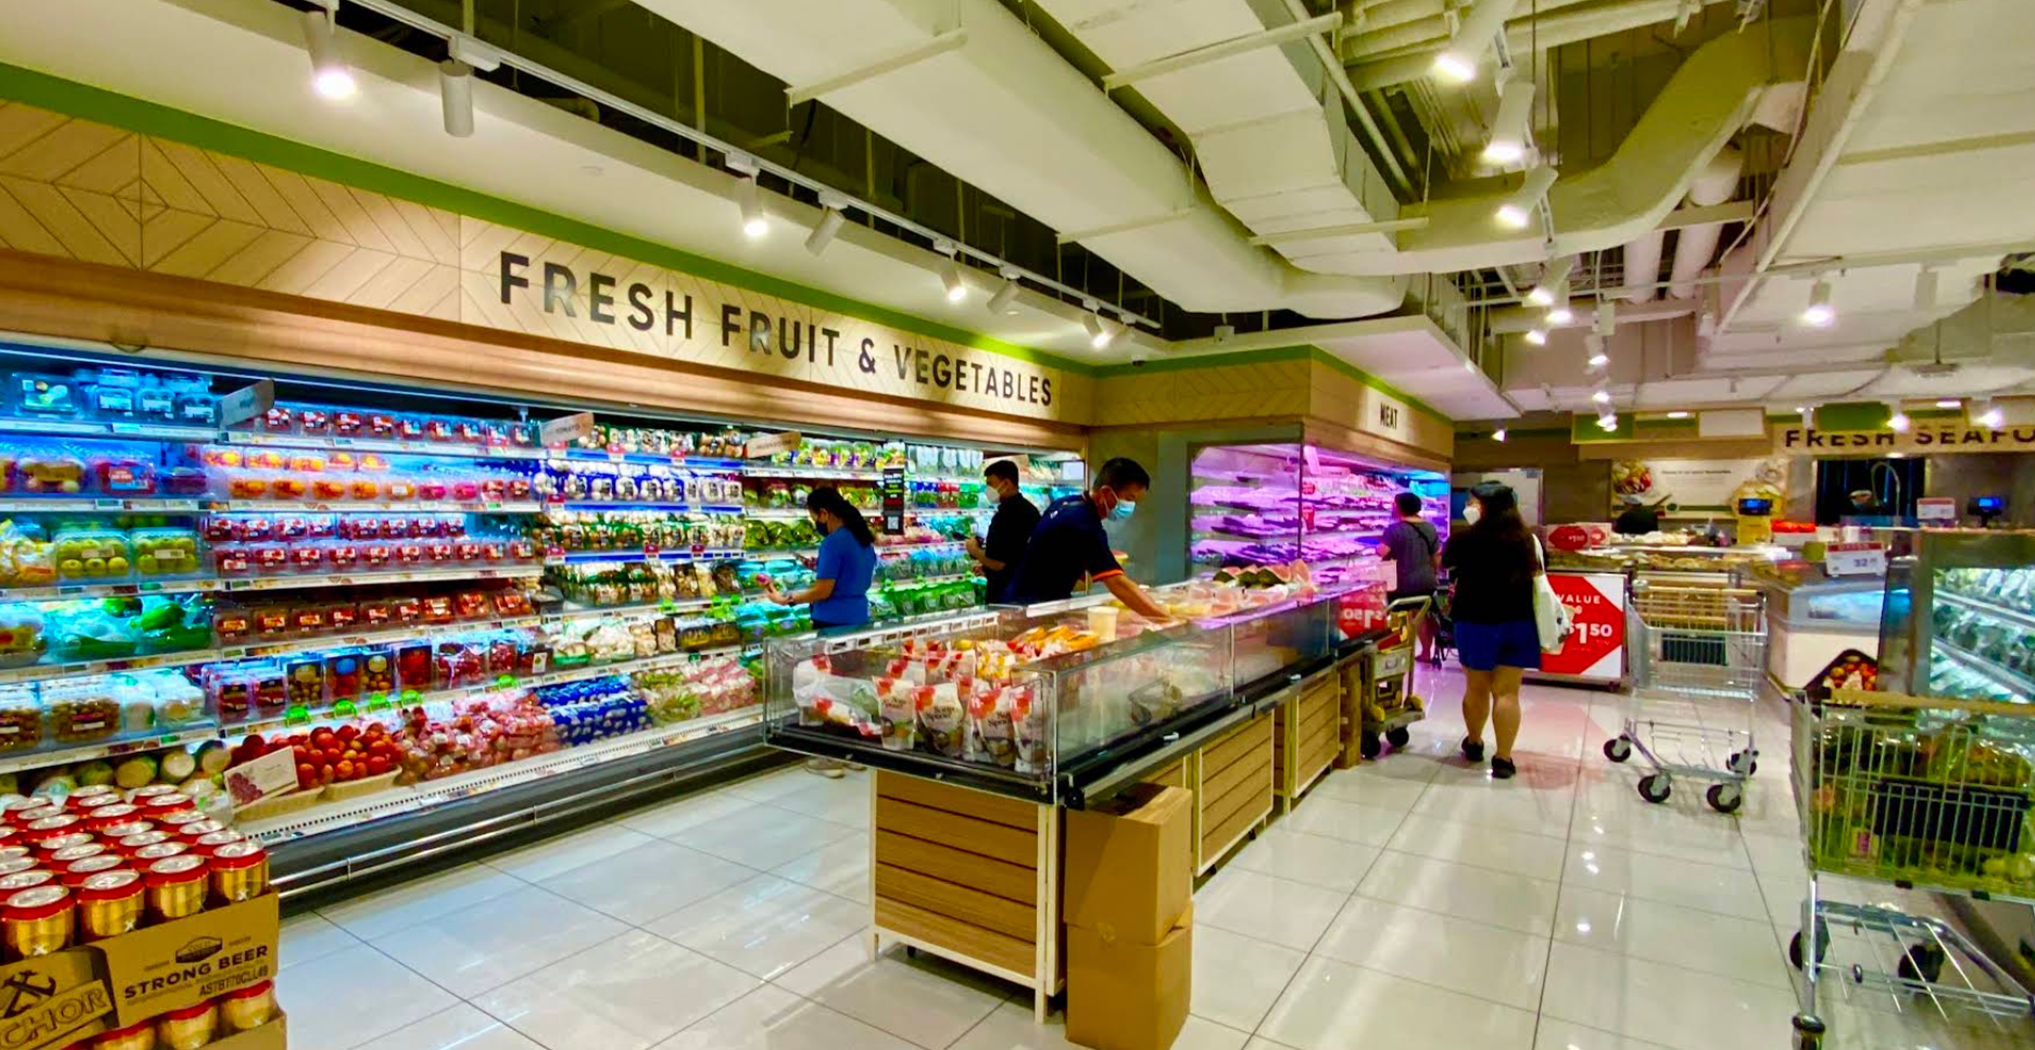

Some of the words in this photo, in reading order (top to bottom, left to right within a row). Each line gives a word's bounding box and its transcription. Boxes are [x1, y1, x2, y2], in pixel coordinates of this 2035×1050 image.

[500, 250, 693, 340] FRESH
[722, 305, 841, 367] FRUIT
[858, 337, 877, 374] &
[894, 344, 1053, 408] VEGETABLES
[1379, 402, 1398, 430] MEAT
[1785, 429, 1895, 448] FRESH
[1557, 593, 1601, 605] VALUE
[124, 963, 212, 999] STRONG
[218, 945, 269, 970] BEER
